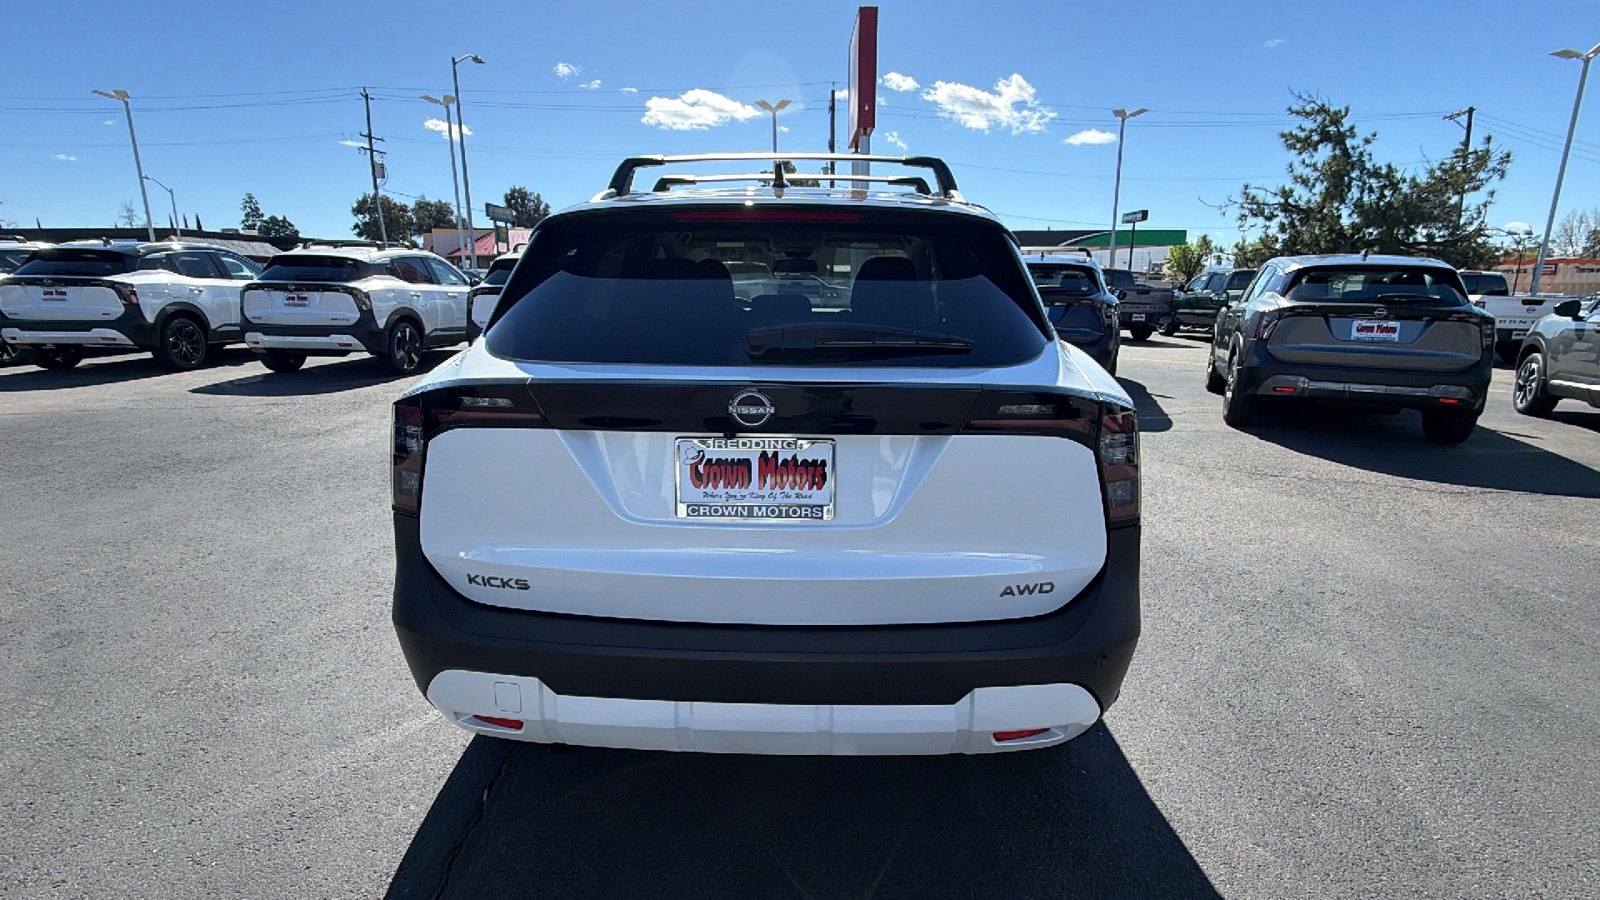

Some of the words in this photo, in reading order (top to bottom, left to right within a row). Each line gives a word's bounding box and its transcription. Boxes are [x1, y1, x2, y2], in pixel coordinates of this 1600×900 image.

[729, 406, 774, 414] NISSAN
[713, 440, 796, 449] REDDING
[689, 450, 752, 490] Crown
[757, 450, 828, 491] Motors
[702, 491, 722, 499] Where
[748, 491, 766, 501] King
[768, 491, 778, 500] Of
[780, 491, 793, 500] The
[794, 492, 813, 500] Road
[687, 505, 748, 517] CROWN
[753, 506, 823, 518] MOTORS
[467, 573, 531, 591] KICKS
[999, 581, 1055, 597] AWD
